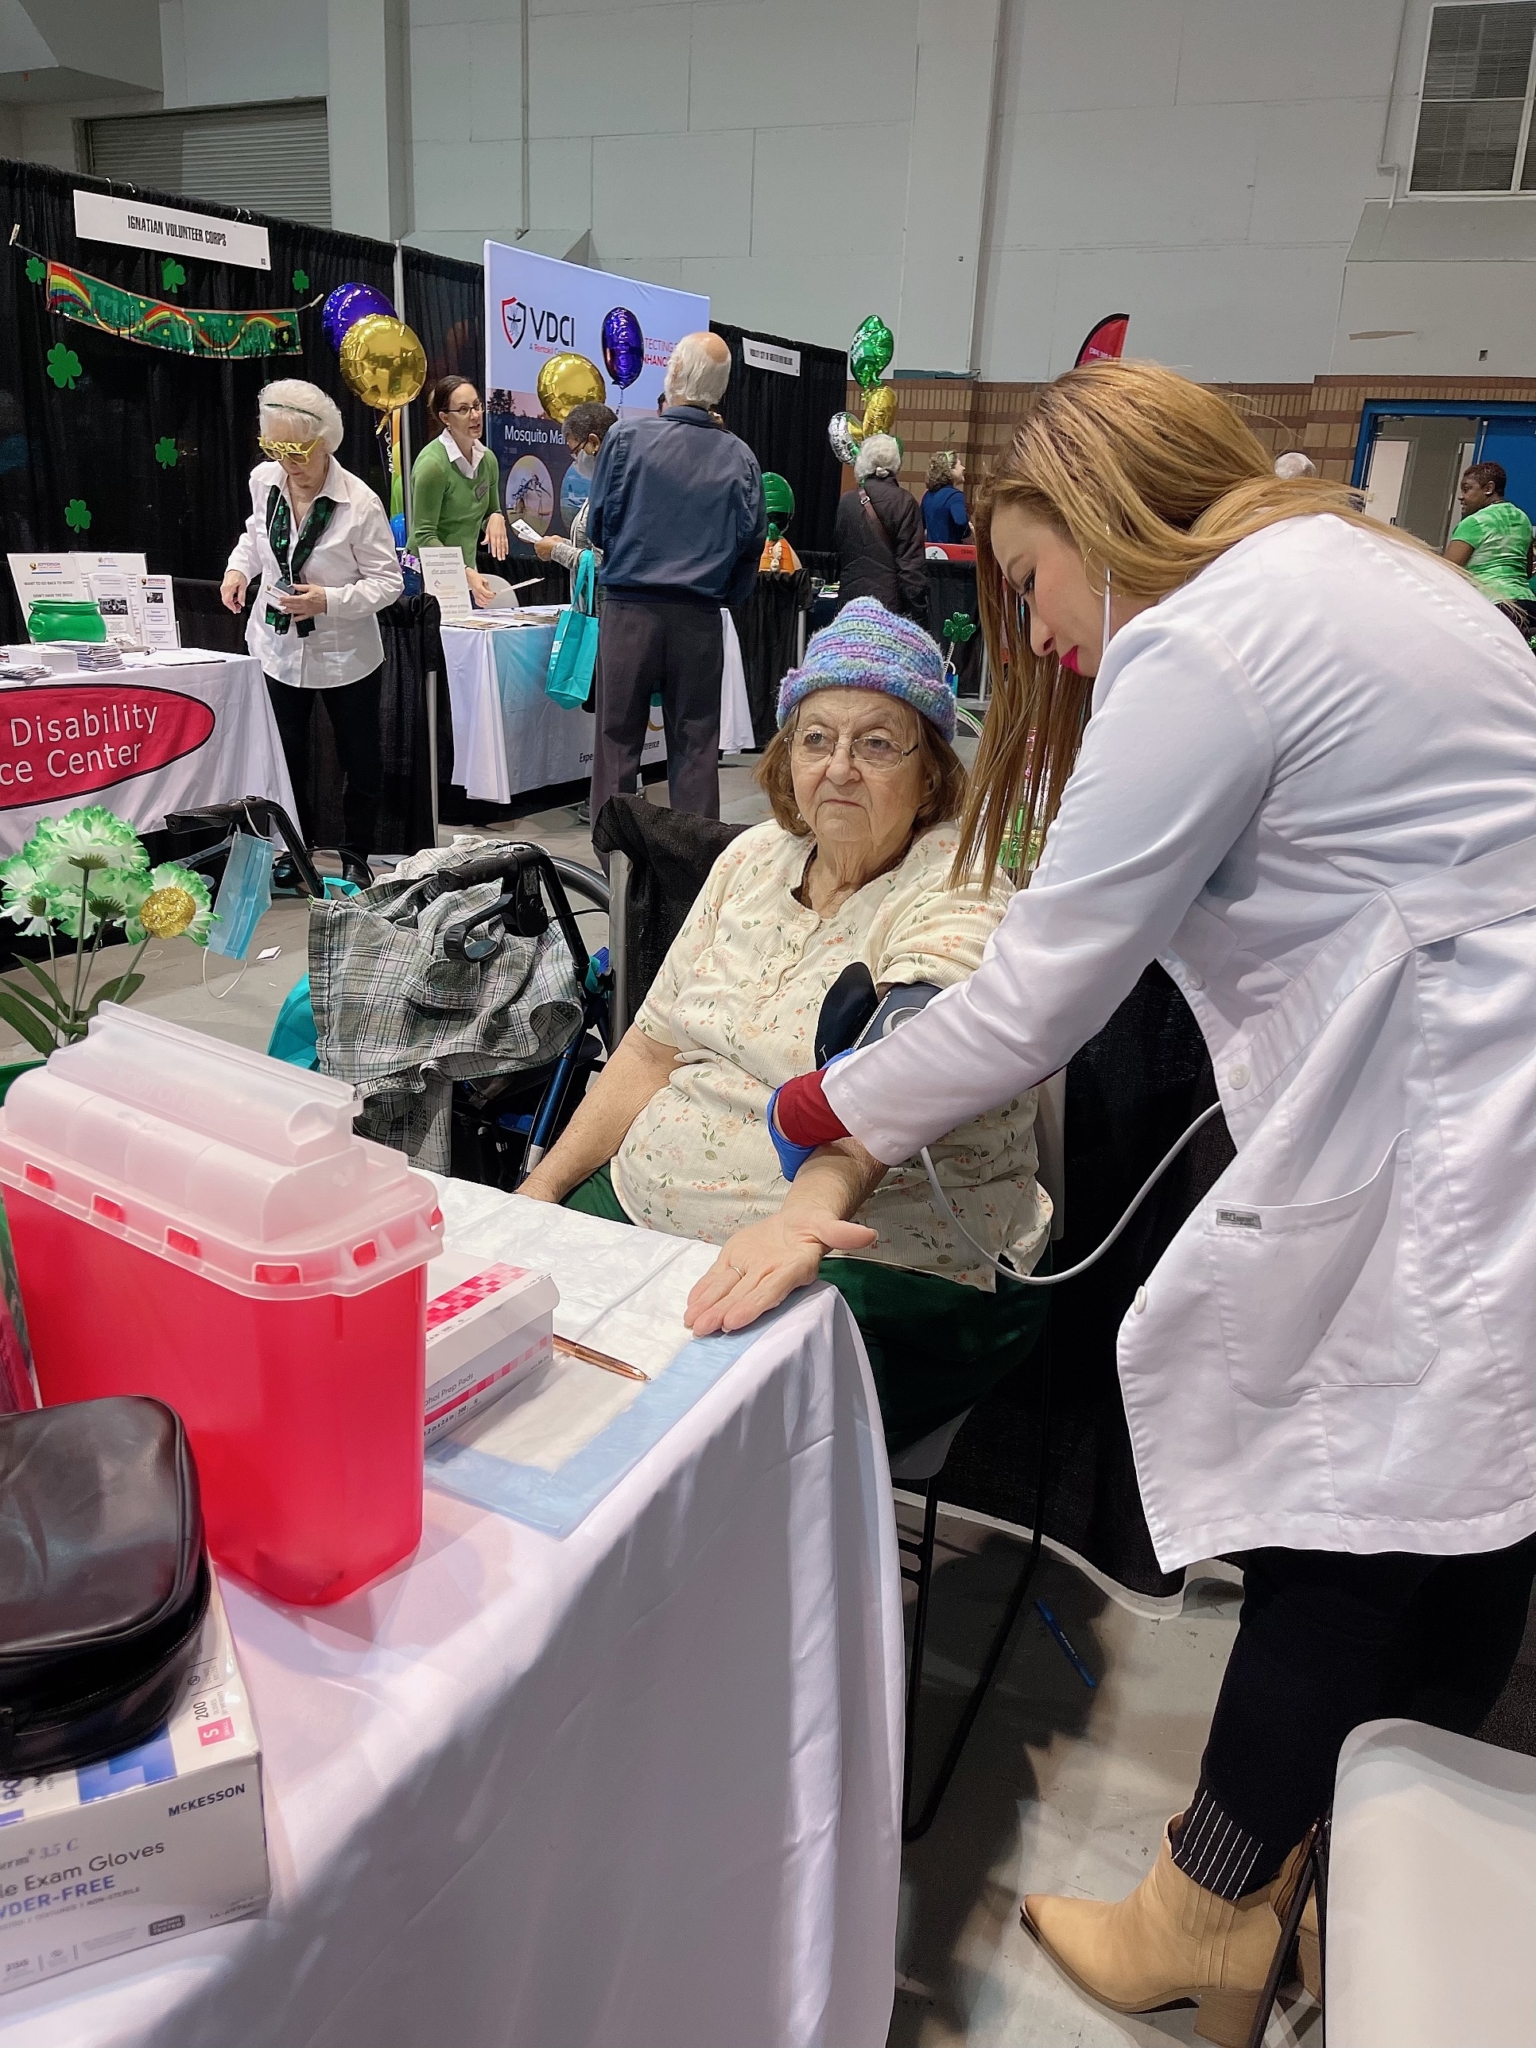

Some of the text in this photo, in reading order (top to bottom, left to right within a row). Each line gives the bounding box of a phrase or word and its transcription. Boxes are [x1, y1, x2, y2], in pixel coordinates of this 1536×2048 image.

[127, 215, 227, 247] IGNATIAN VOLUNTEER CORPS
[529, 307, 575, 347] VDCI
[504, 424, 548, 446] Mosquito
[10, 703, 158, 747] Disability
[47, 742, 142, 778] Center
[441, 1383, 457, 1398] Prep
[458, 1373, 474, 1387] Pads
[193, 1701, 209, 1721] 200
[203, 1728, 220, 1739] S
[66, 1837, 79, 1852] C
[24, 1865, 82, 1891] Exam
[89, 1841, 165, 1872] Gloves
